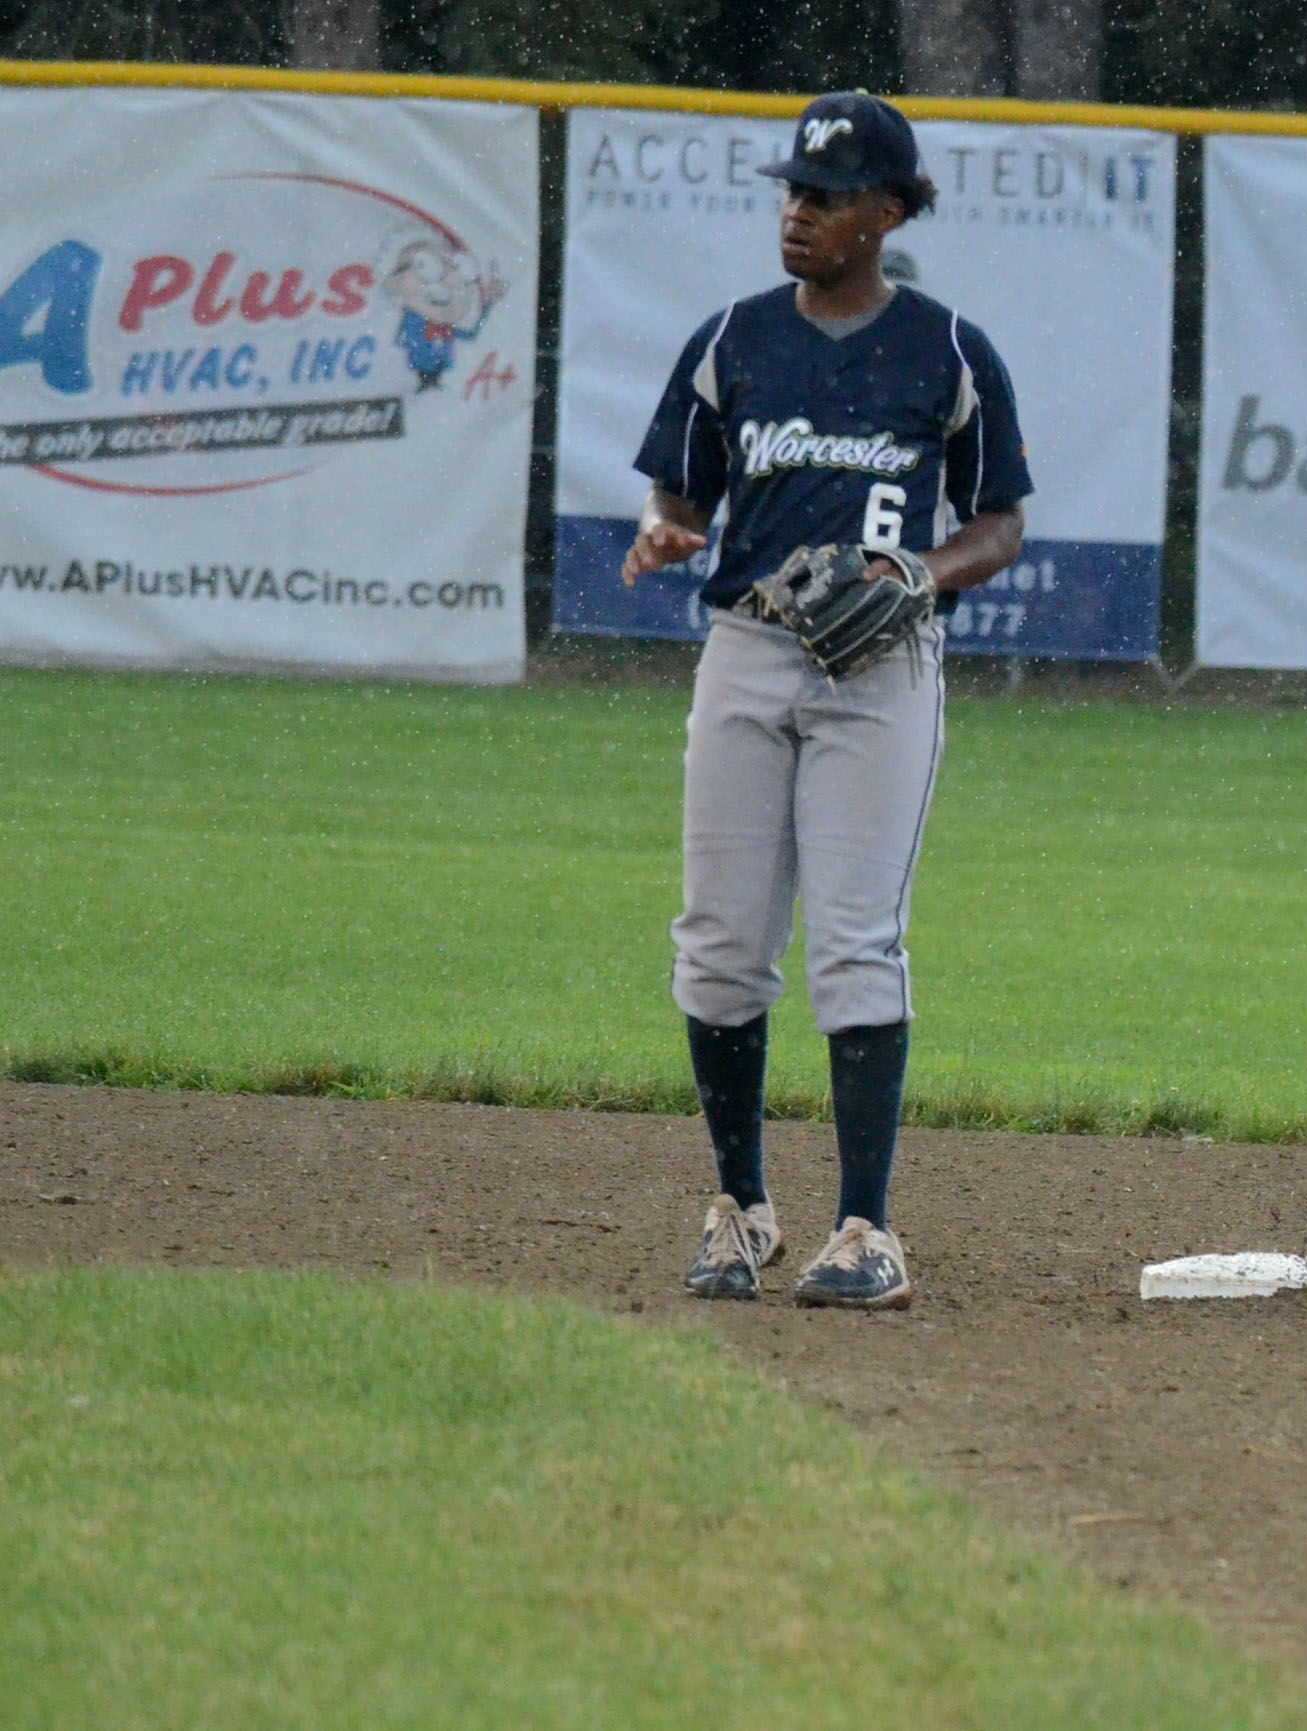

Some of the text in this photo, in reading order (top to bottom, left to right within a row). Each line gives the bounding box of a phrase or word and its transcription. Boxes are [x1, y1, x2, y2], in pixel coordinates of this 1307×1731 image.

[588, 133, 1153, 202] ACCELTED IT
[804, 117, 853, 153] W
[118, 251, 375, 333] Plus
[120, 336, 377, 396] HVAC, INC
[739, 416, 920, 479] Worcester
[863, 482, 907, 550] 6
